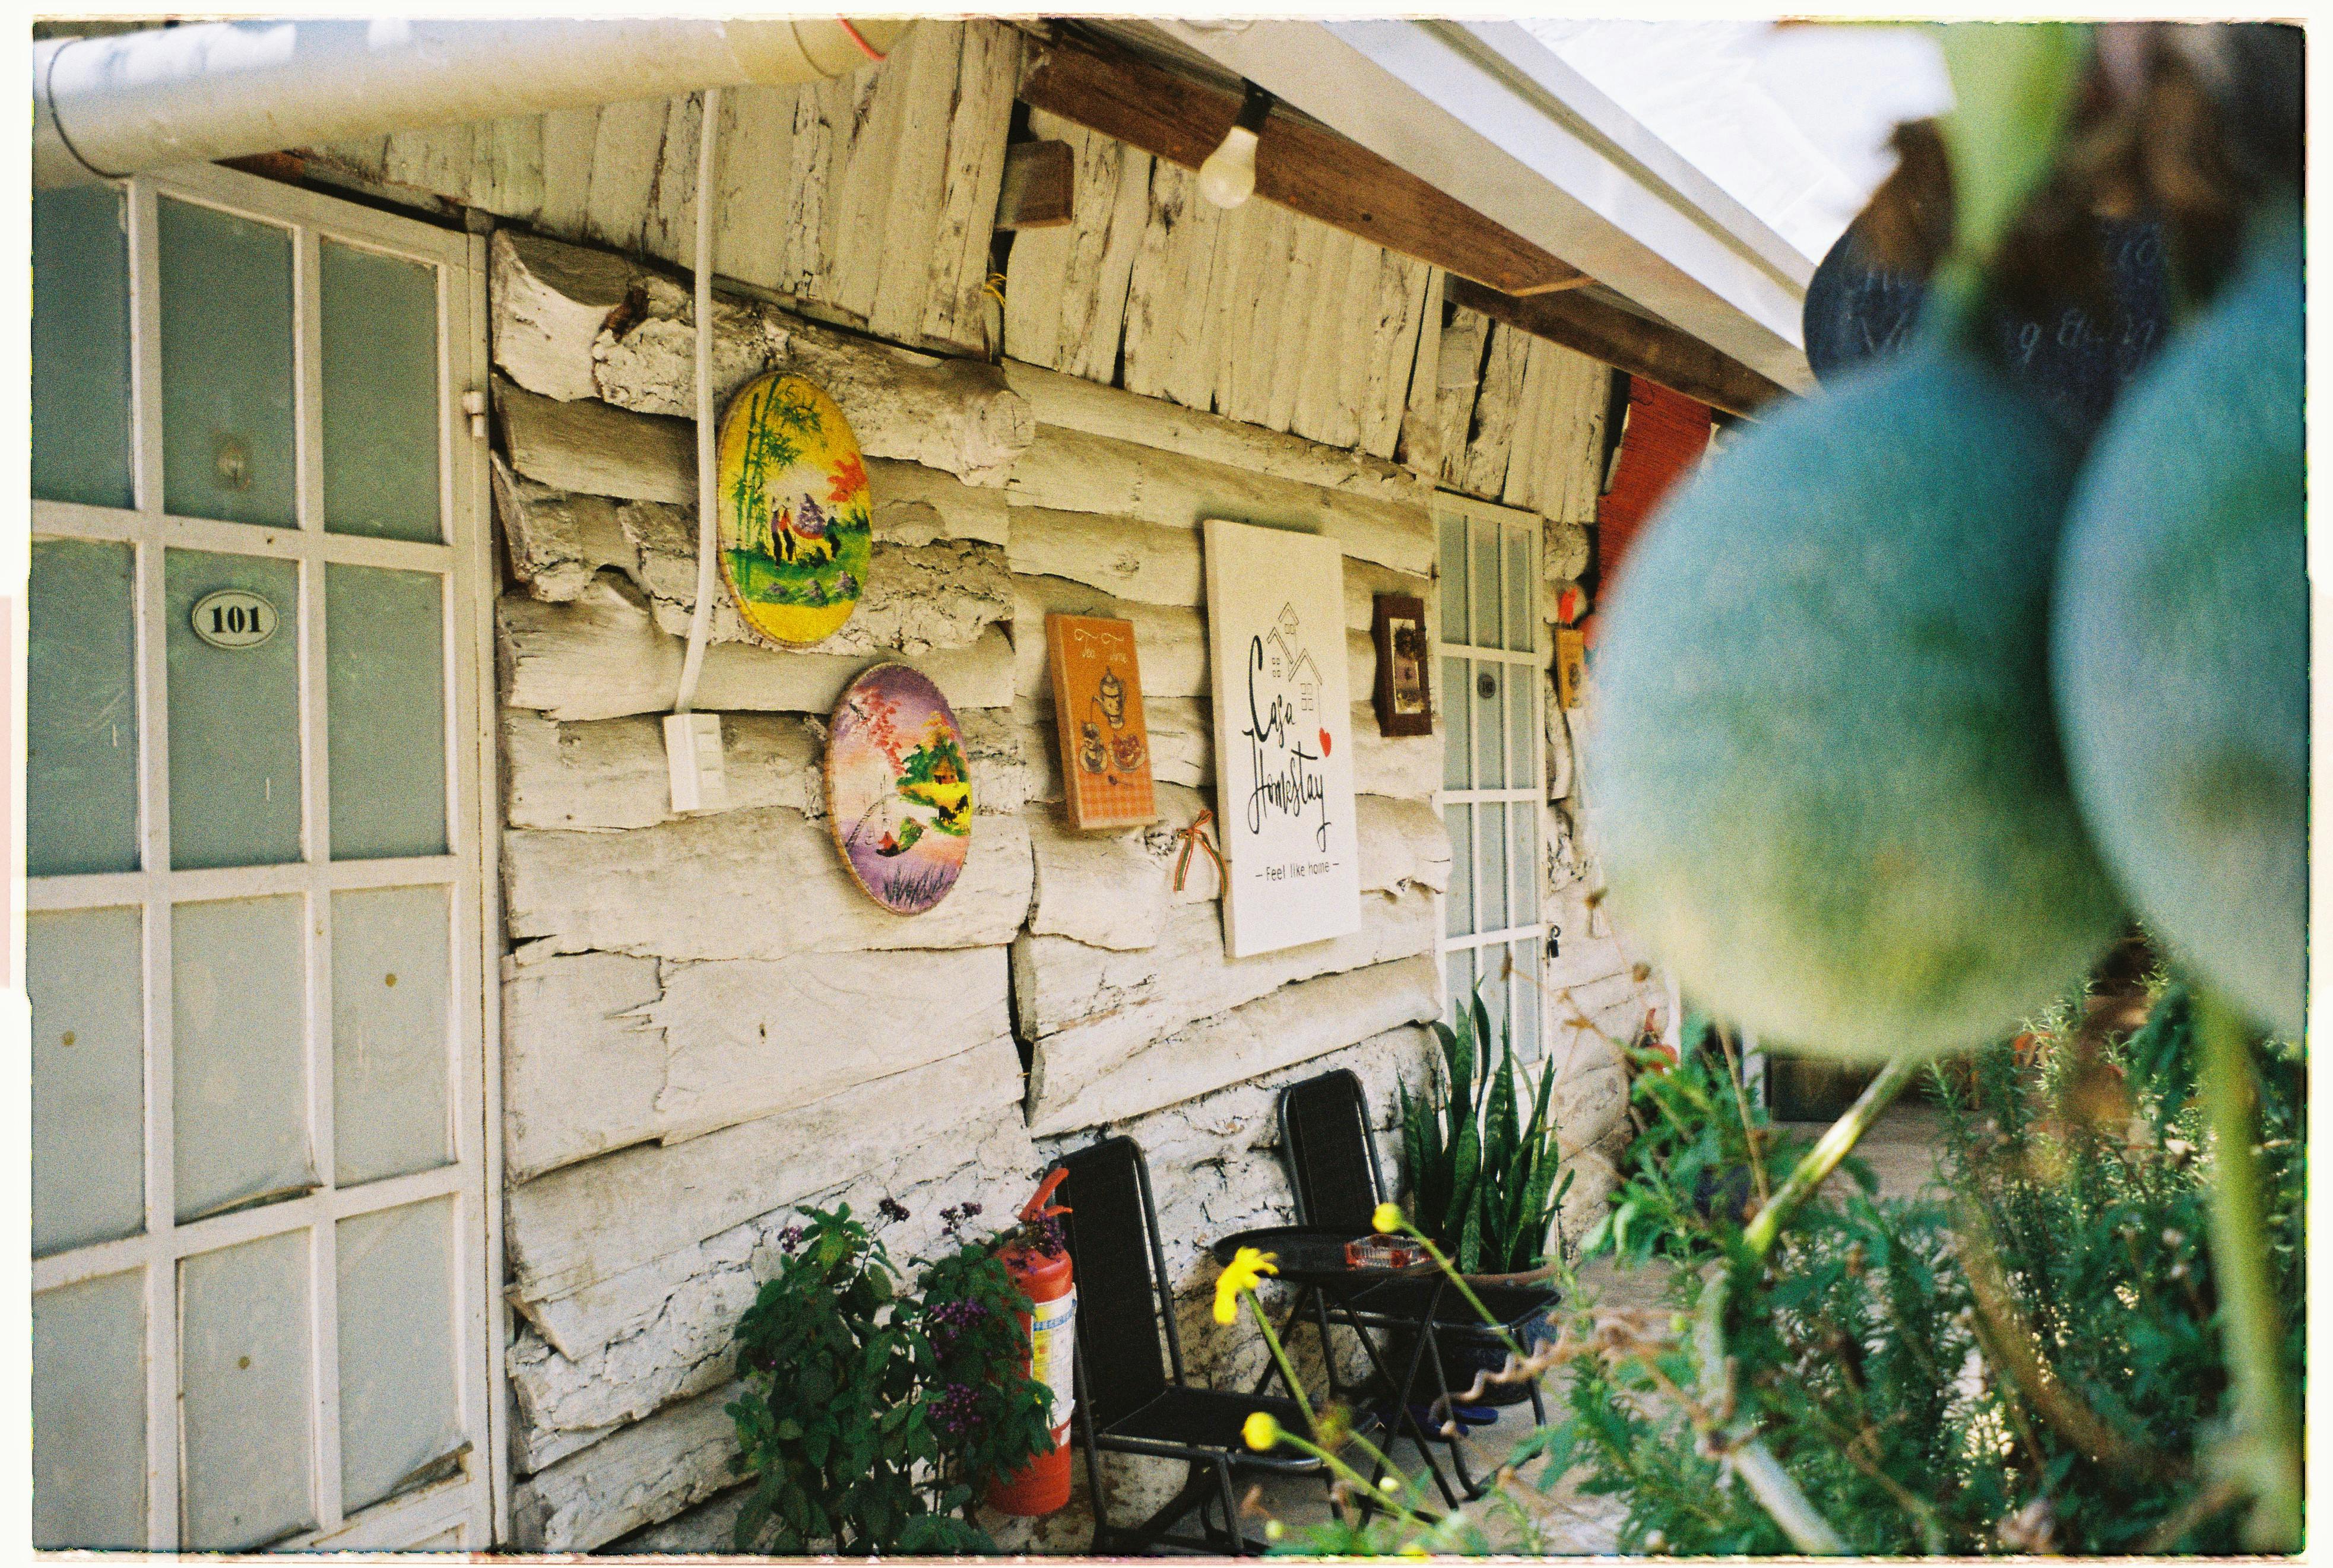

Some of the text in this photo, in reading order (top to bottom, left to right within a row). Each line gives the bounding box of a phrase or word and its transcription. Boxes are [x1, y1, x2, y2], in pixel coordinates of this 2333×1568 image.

[210, 605, 262, 633] 101
[1248, 634, 1296, 748] Casa
[1266, 861, 1330, 881] Feel like home
